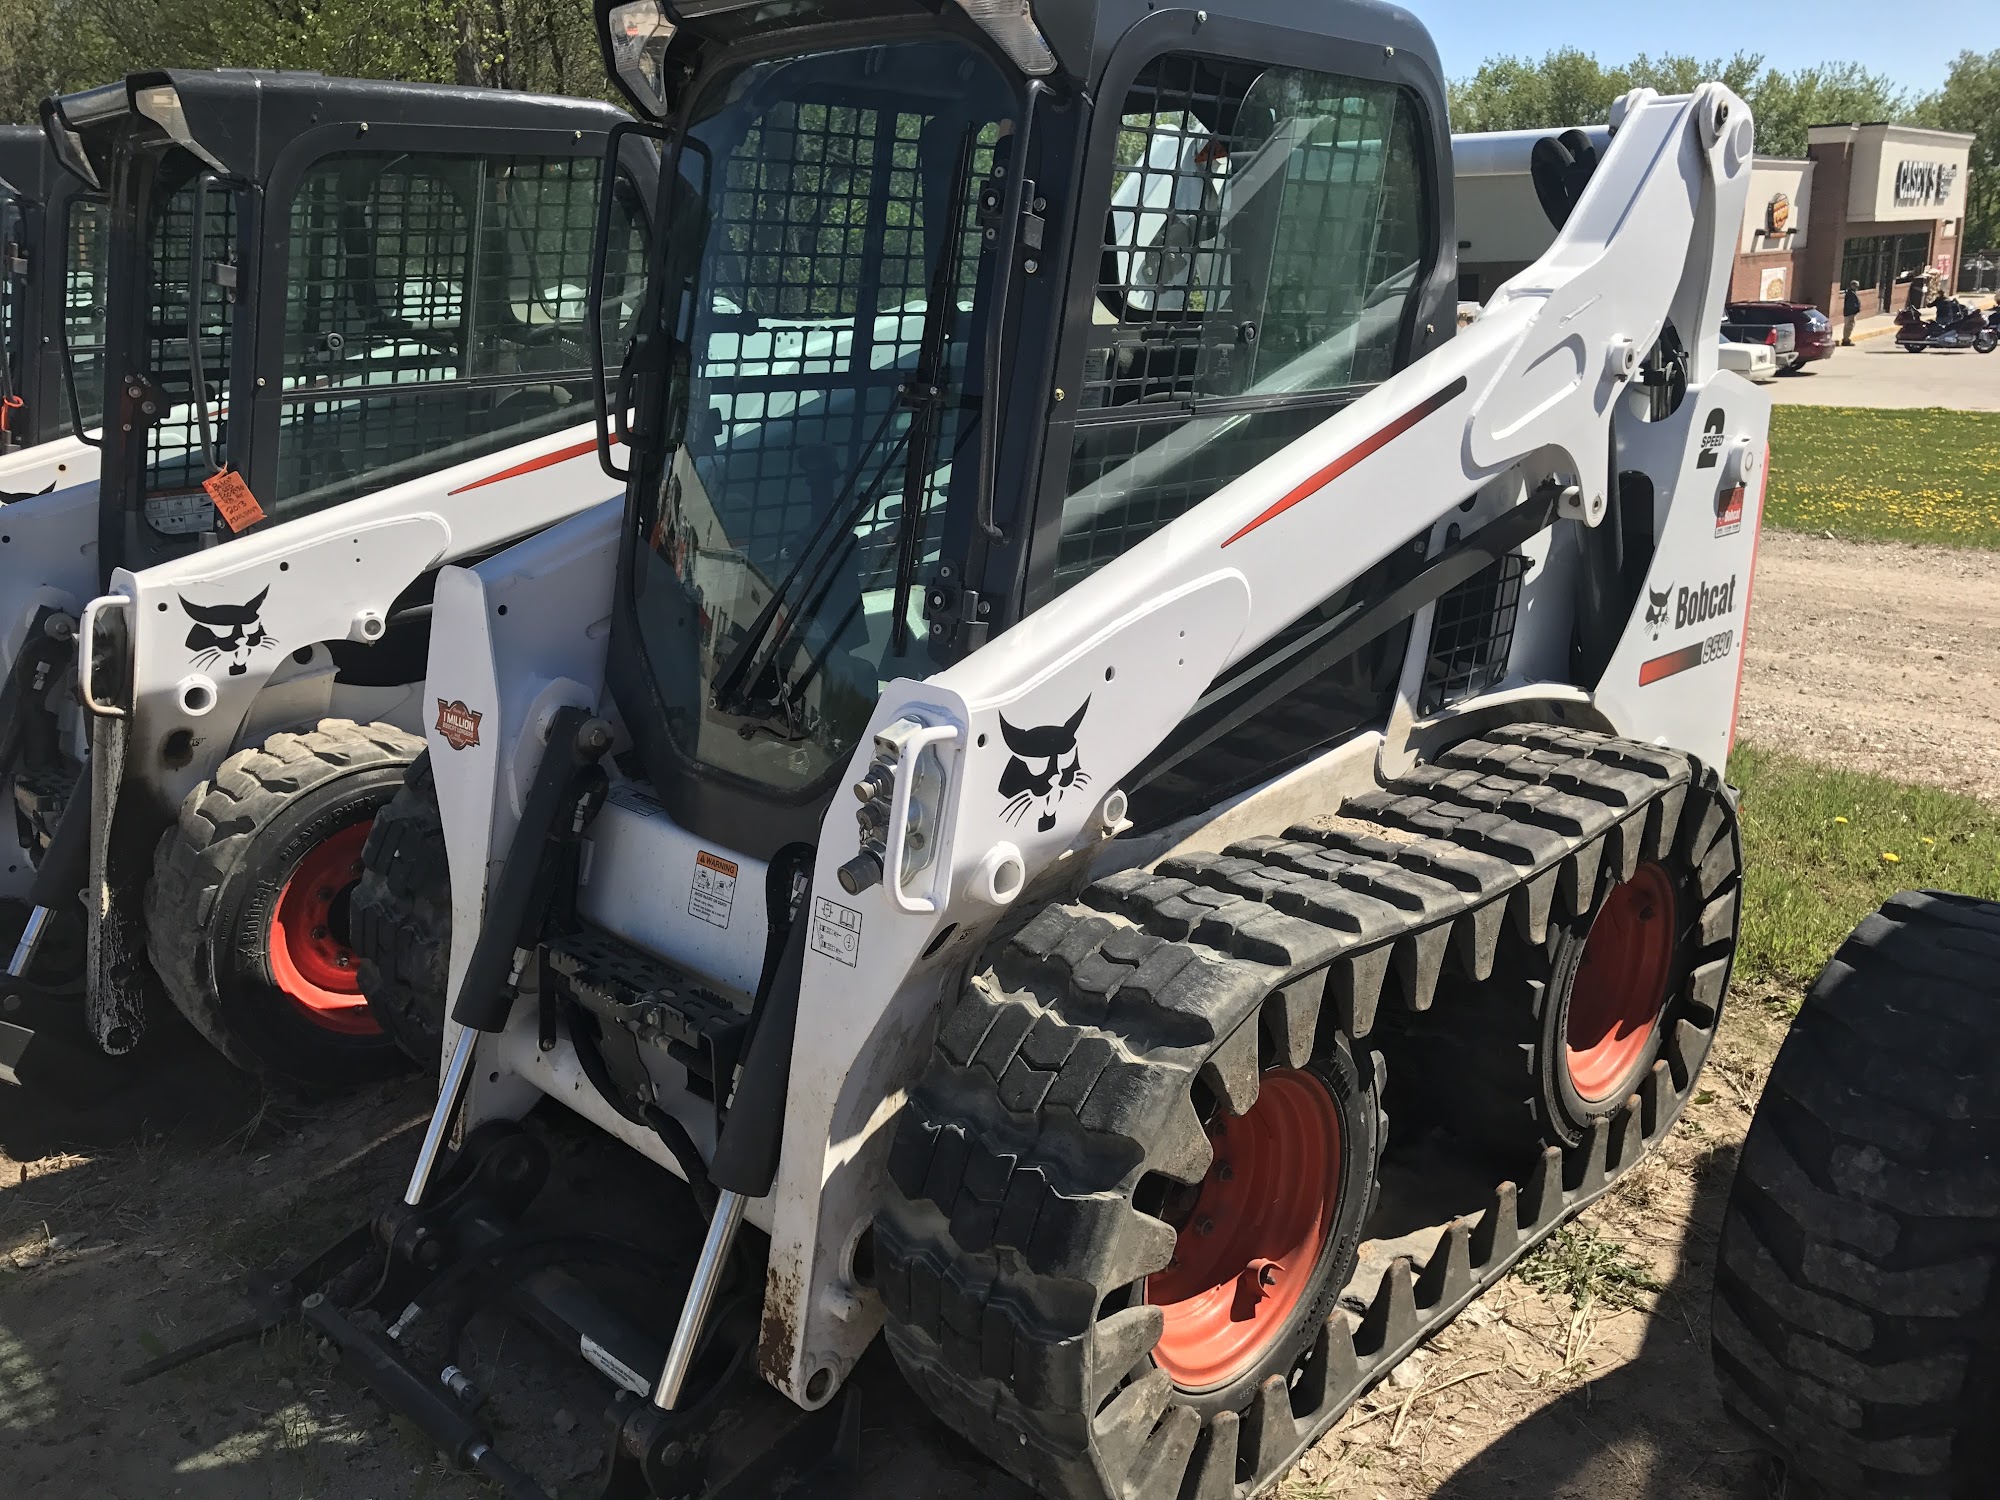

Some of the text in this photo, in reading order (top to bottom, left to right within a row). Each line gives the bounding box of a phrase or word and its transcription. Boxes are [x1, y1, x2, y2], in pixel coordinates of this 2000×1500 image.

[1696, 407, 1725, 469] 2
[1701, 435, 1724, 448] SPEED
[226, 500, 247, 514] 2013
[1675, 574, 1736, 630] Bobcat
[1702, 629, 1733, 665] S590
[446, 713, 474, 731] MILLION
[706, 857, 734, 873] WARNING
[241, 880, 275, 939] Bobcat
